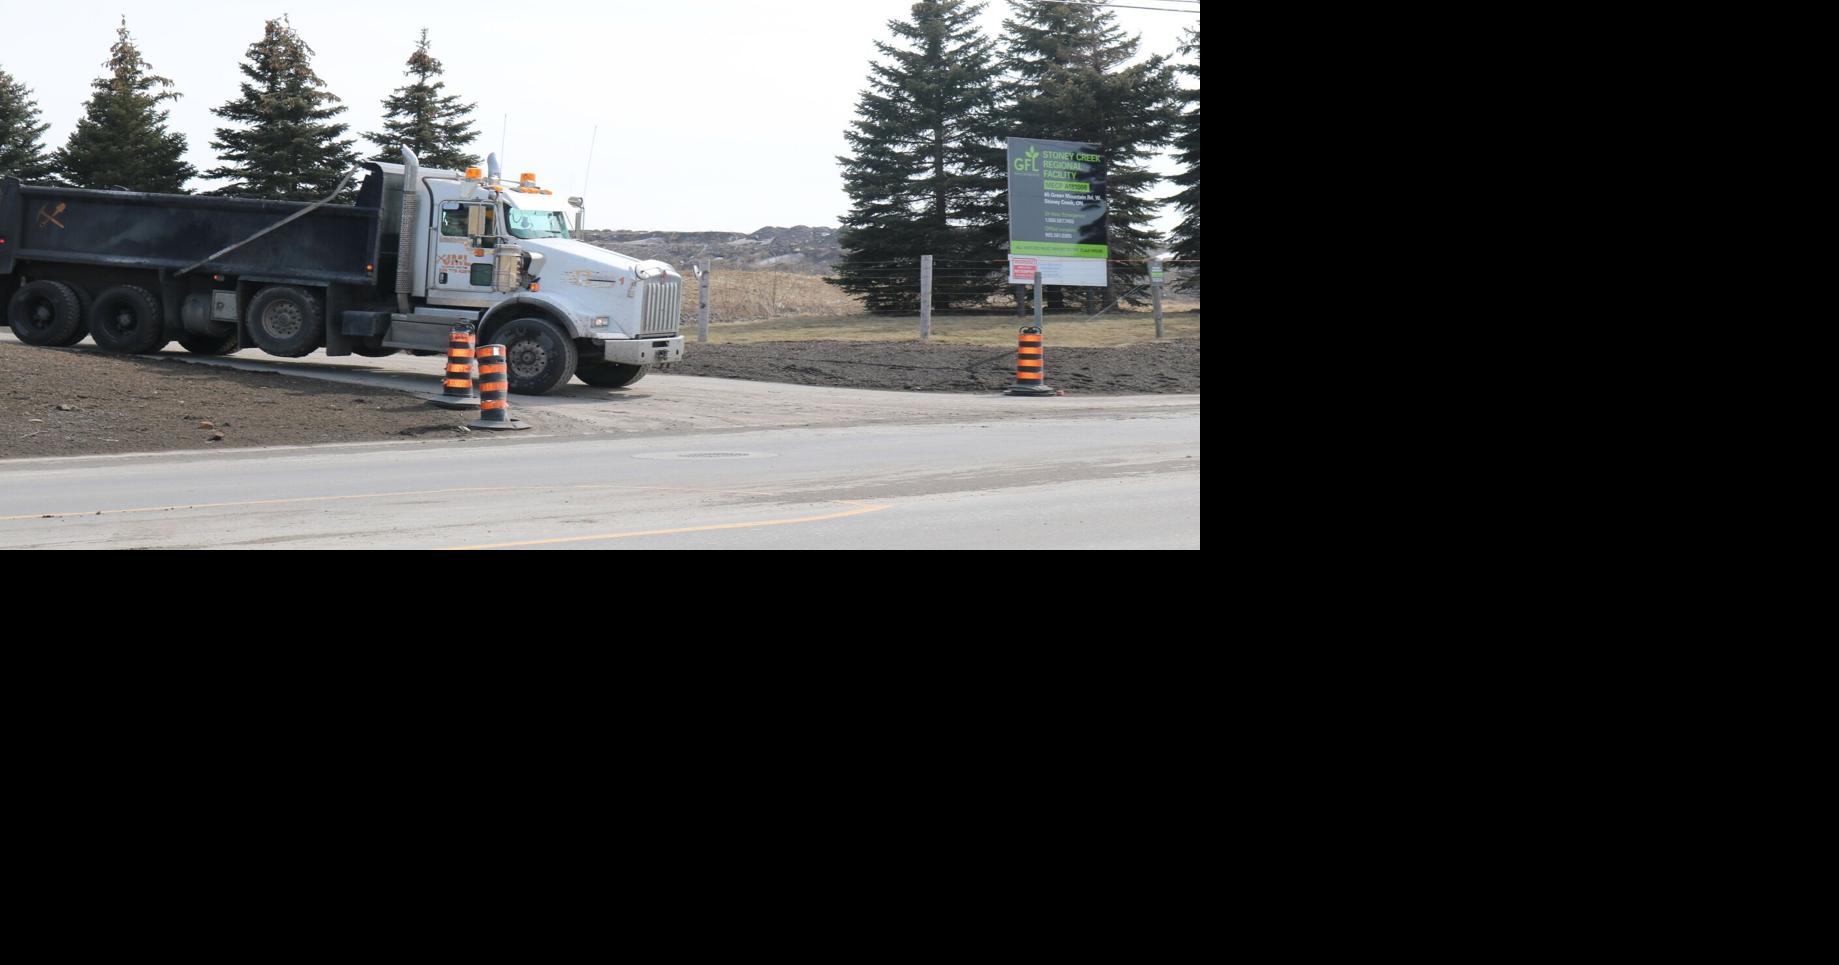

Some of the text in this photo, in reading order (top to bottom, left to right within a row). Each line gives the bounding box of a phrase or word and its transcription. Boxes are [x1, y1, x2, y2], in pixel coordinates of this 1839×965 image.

[1043, 151, 1100, 162] STONEY CREEK
[1014, 157, 1039, 172] GFL
[1043, 161, 1080, 170] REGIONAL
[1043, 170, 1076, 179] FACILITY
